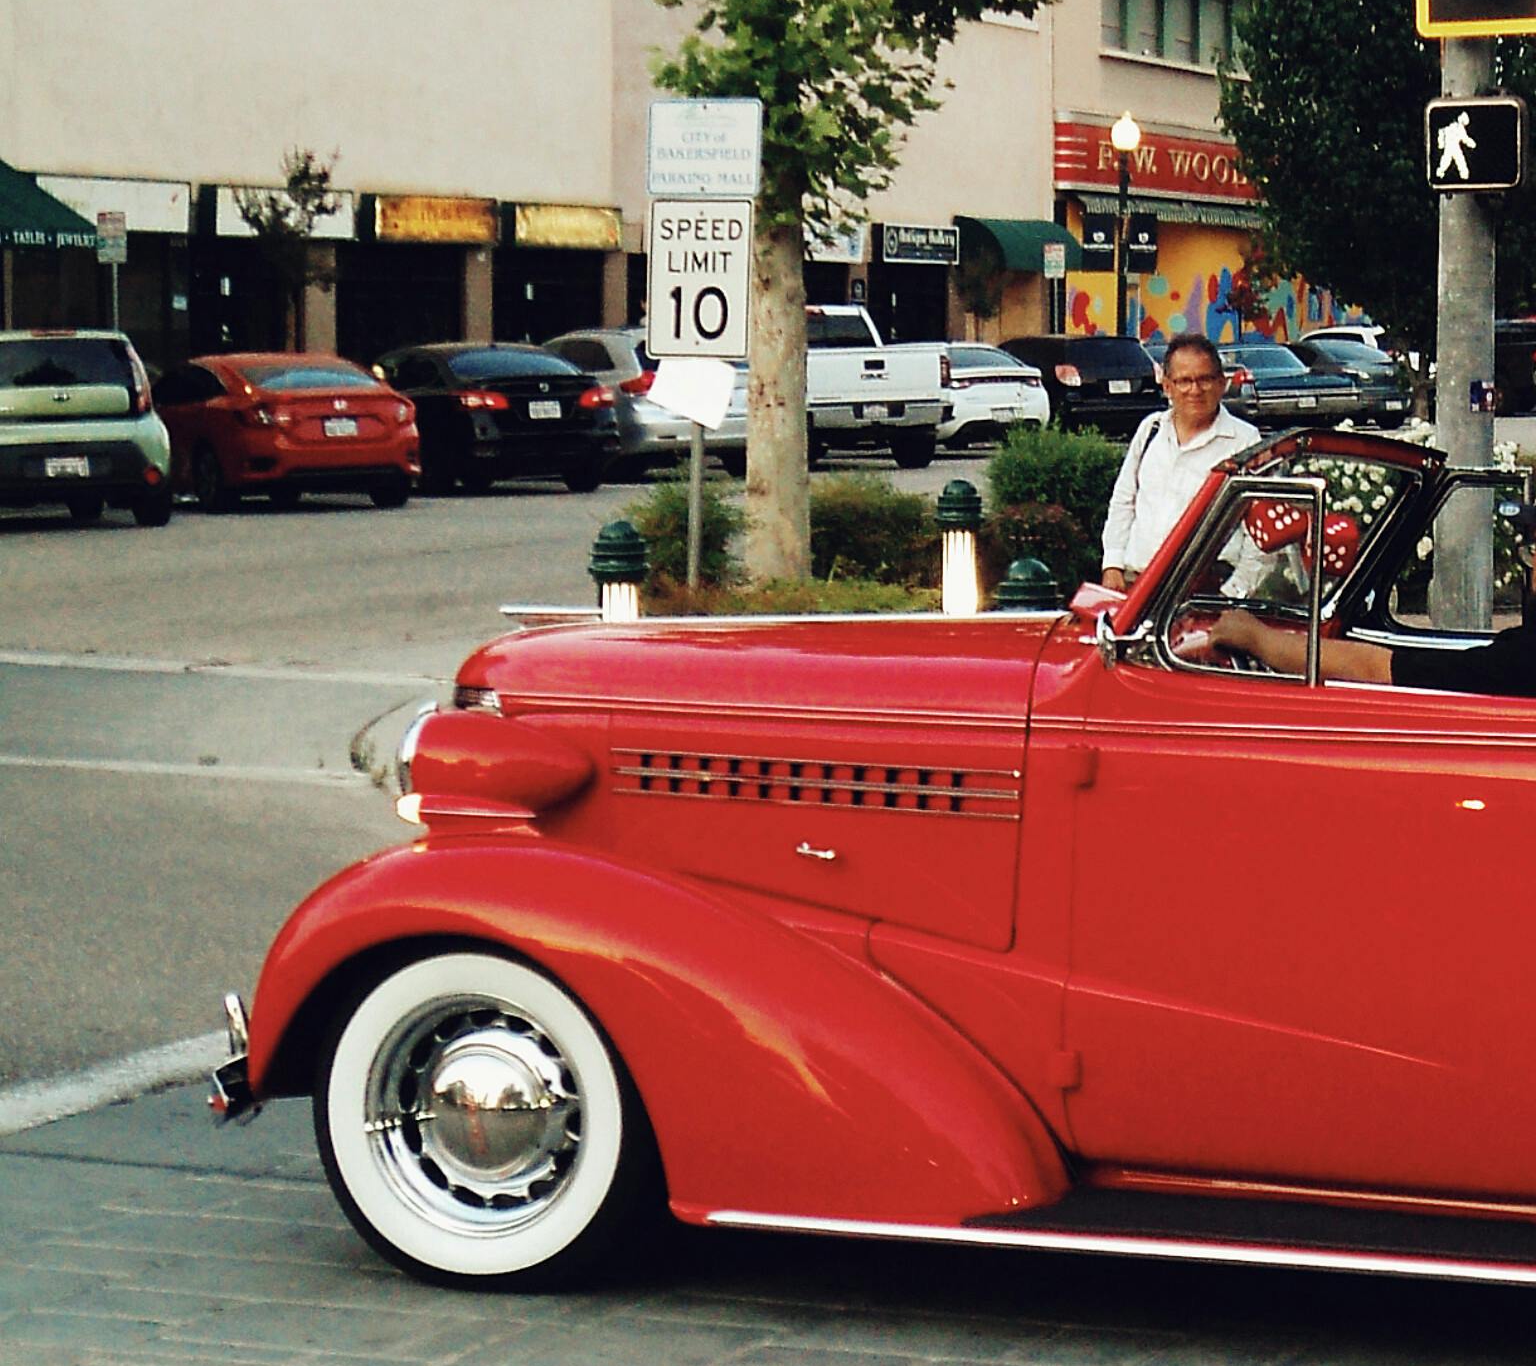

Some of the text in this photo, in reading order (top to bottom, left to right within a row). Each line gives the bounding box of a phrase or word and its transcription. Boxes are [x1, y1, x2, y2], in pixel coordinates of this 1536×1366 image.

[681, 132, 709, 143] CITY
[656, 148, 750, 160] BAKERSFIELD
[652, 173, 753, 184] PARKING MALL
[660, 218, 743, 241] SPEED
[668, 250, 732, 273] LIMIT
[670, 286, 729, 340] 10
